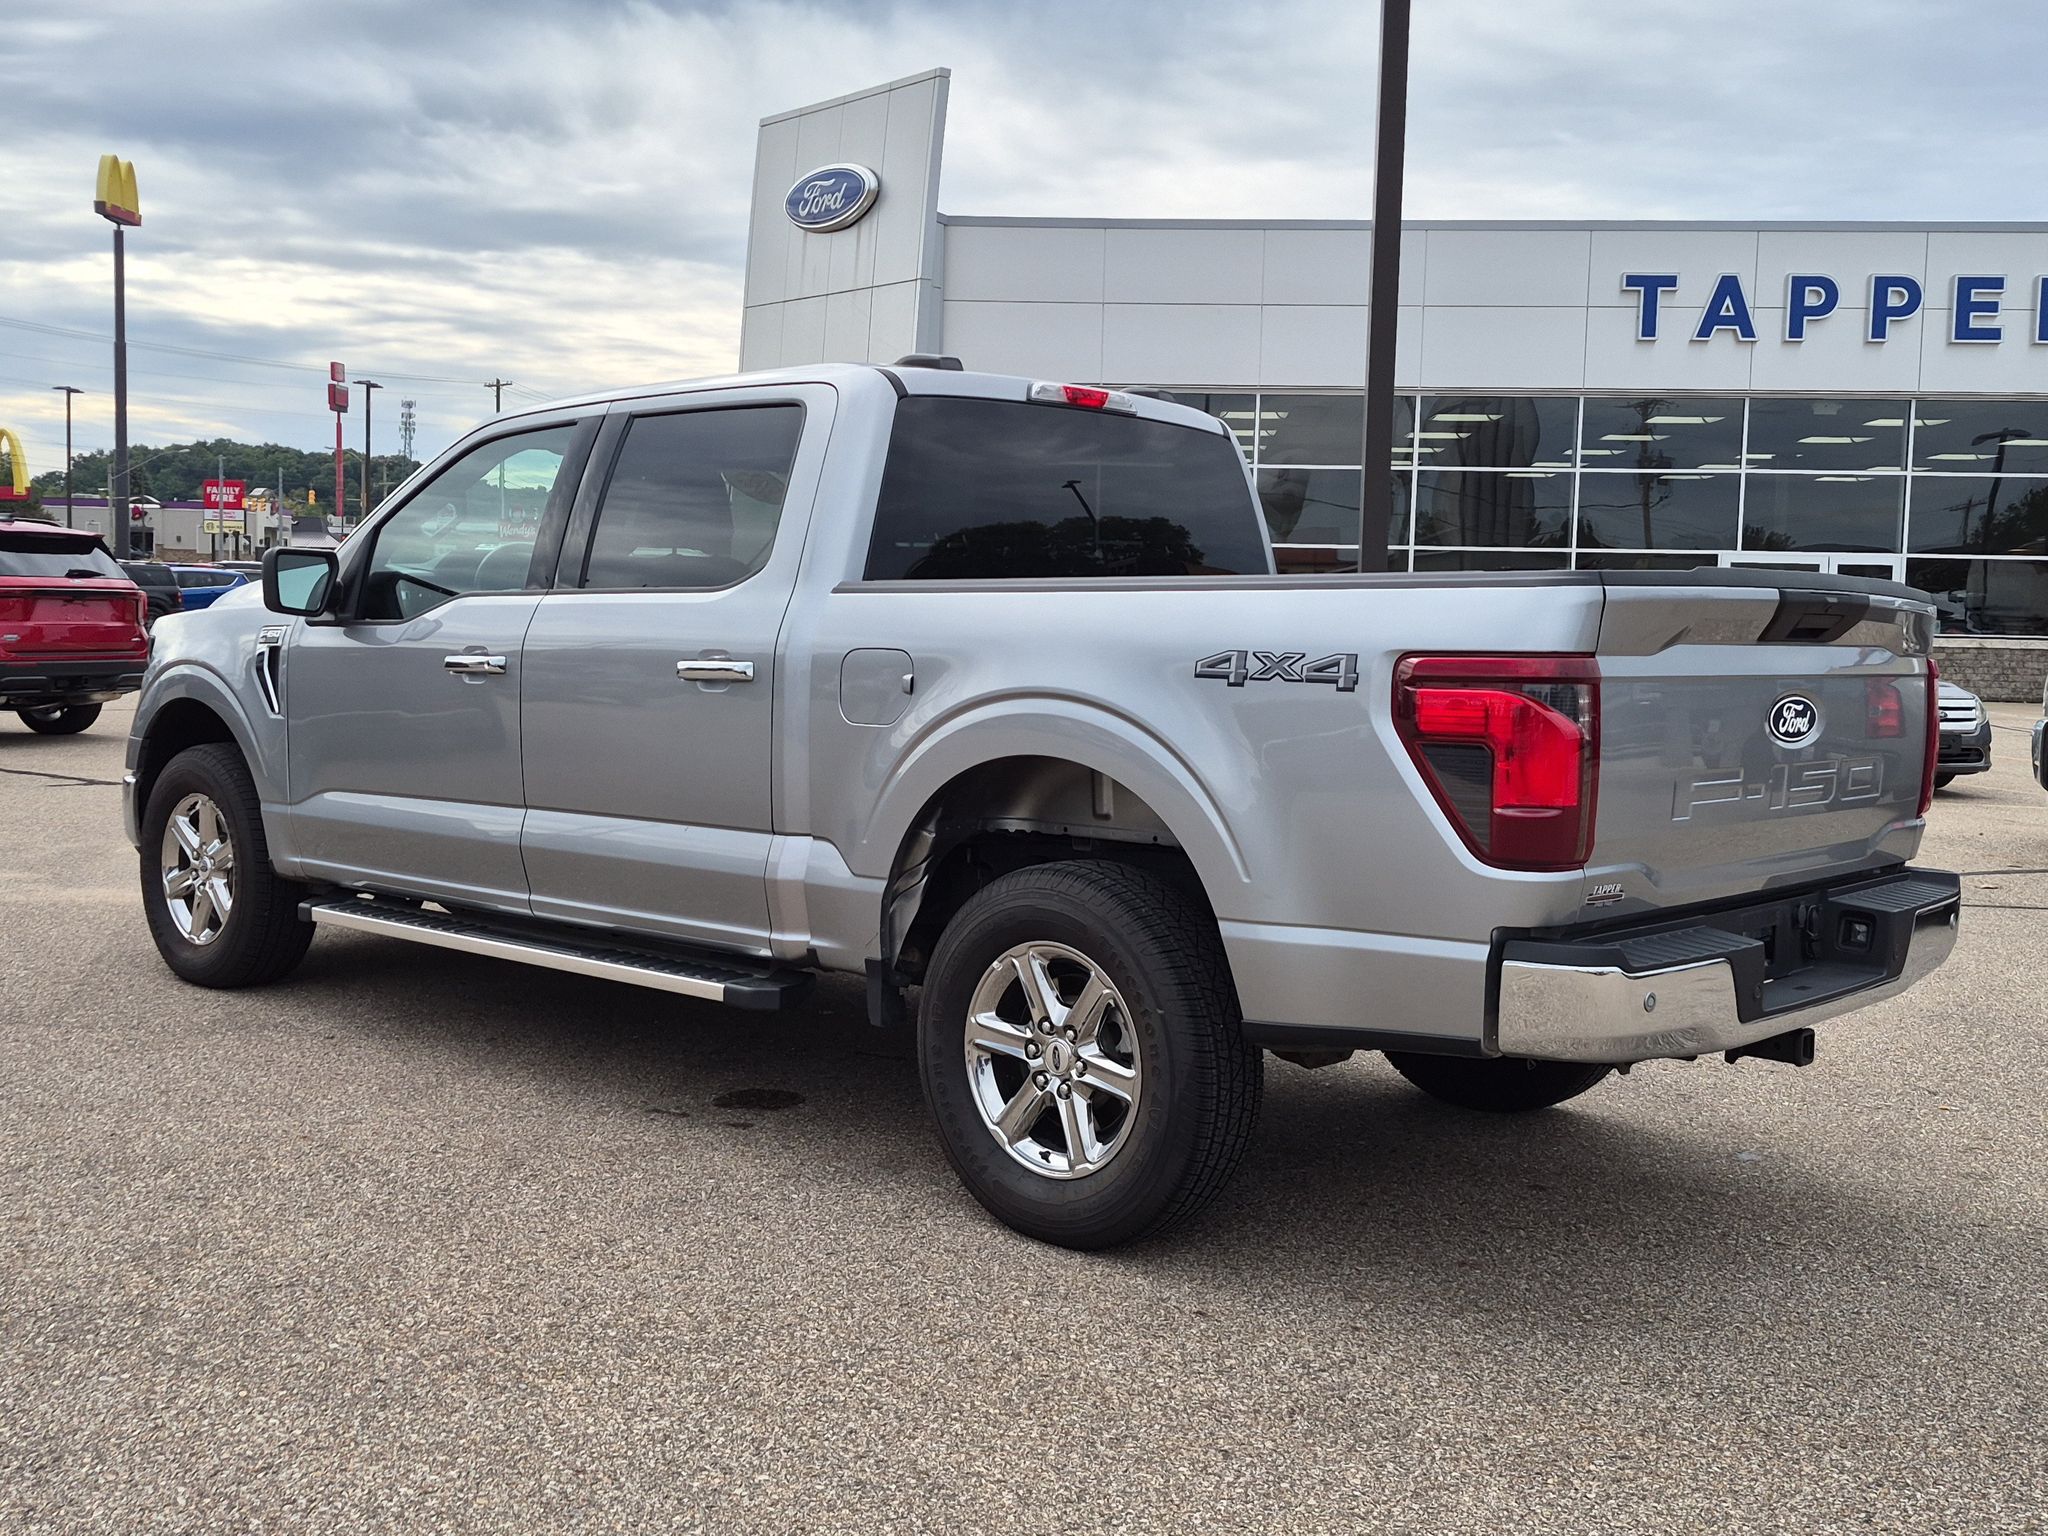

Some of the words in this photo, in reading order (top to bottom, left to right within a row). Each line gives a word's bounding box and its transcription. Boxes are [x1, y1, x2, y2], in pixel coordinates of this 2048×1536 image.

[799, 178, 848, 217] Ford
[1779, 703, 1811, 733] Ford
[1671, 756, 1884, 821] F-150
[1593, 883, 1622, 895] TAPPER
